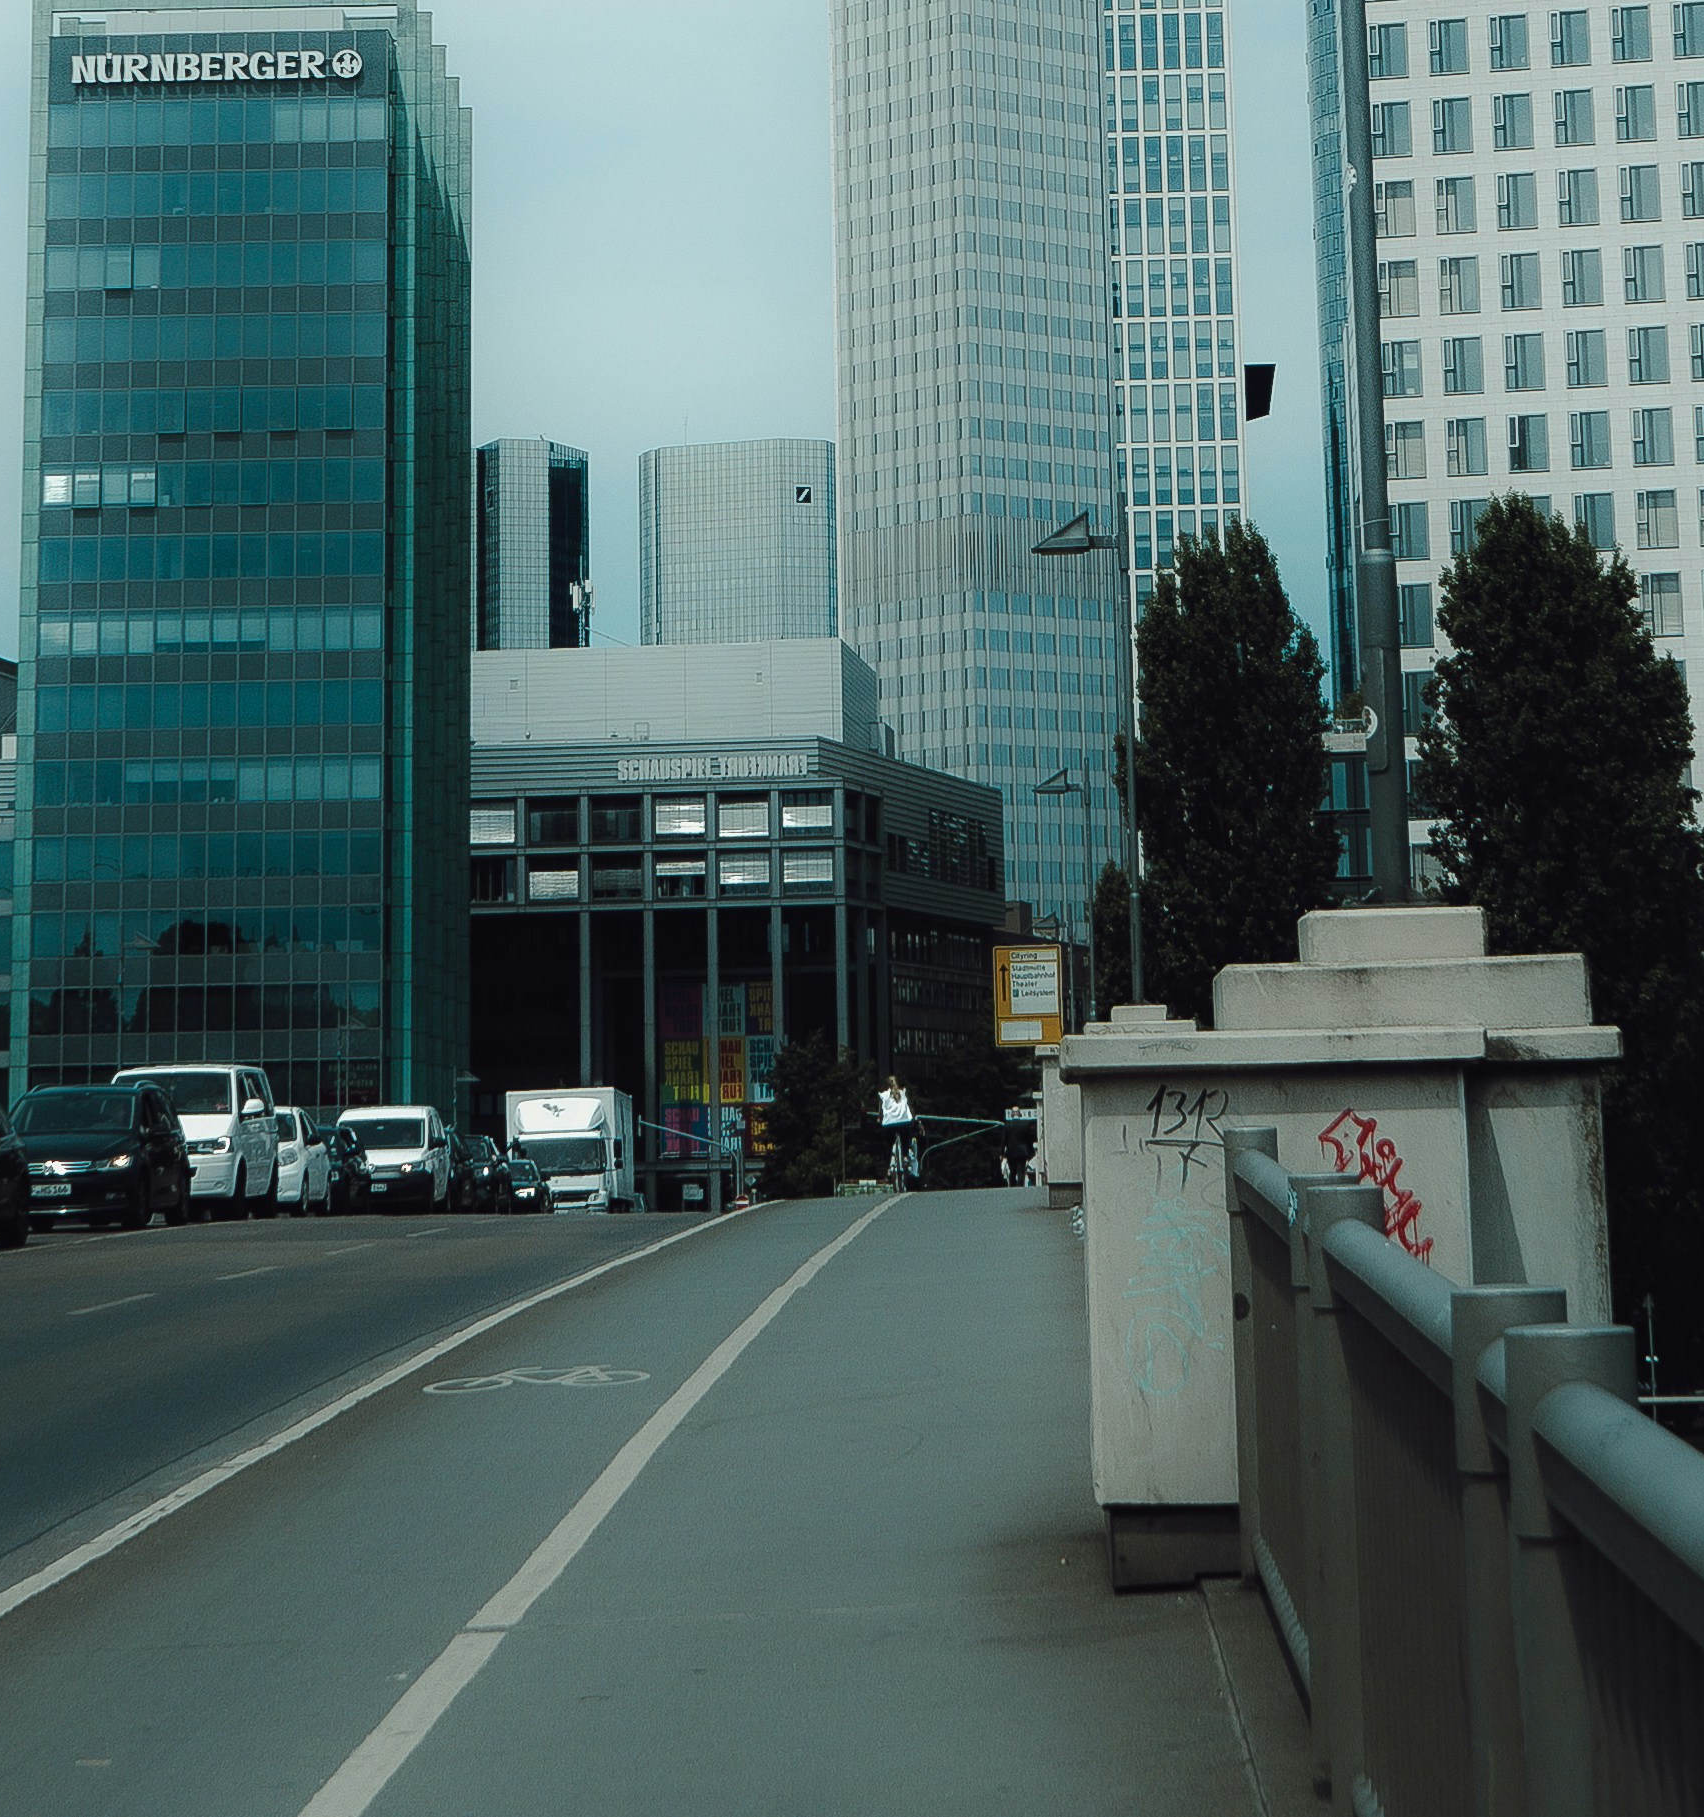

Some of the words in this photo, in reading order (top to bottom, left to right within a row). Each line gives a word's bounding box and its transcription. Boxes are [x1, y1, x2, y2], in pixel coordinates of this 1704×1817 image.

[71, 50, 325, 84] NÜRNBERGER
[617, 757, 721, 781] SCHAUSPIEL
[1011, 952, 1037, 960] Cityring
[1011, 972, 1055, 980] Hauptbahnhof
[664, 1041, 699, 1055] SCHAU
[664, 1056, 693, 1070] SPIEL
